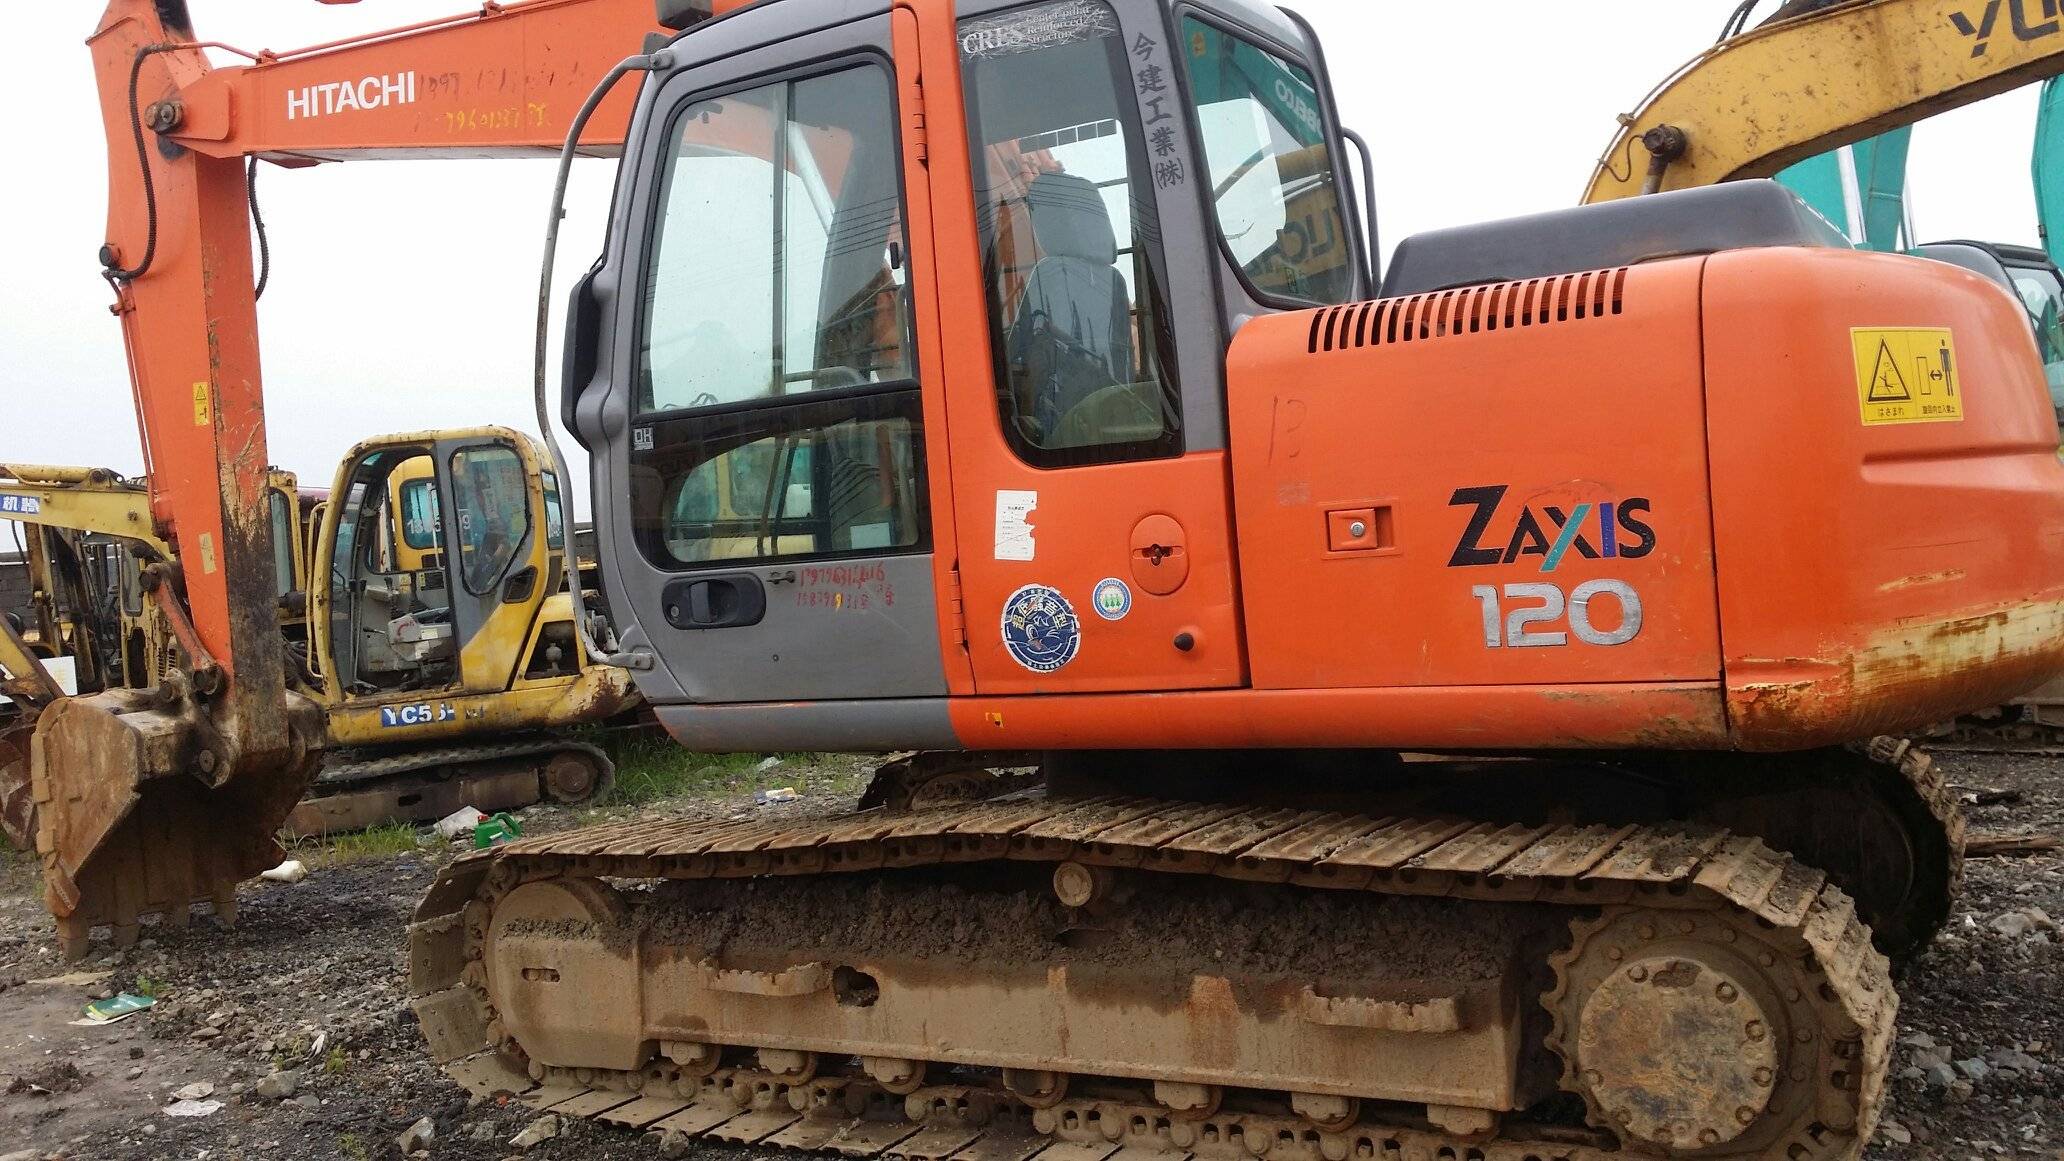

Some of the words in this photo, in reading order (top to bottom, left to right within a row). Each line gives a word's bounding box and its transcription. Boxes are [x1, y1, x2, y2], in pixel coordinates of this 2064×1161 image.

[963, 26, 1023, 54] CRES
[1948, 0, 2064, 58] YU
[287, 70, 416, 120] HITACHI
[1447, 484, 1657, 573] ZAXIS
[1471, 578, 1643, 648] 120
